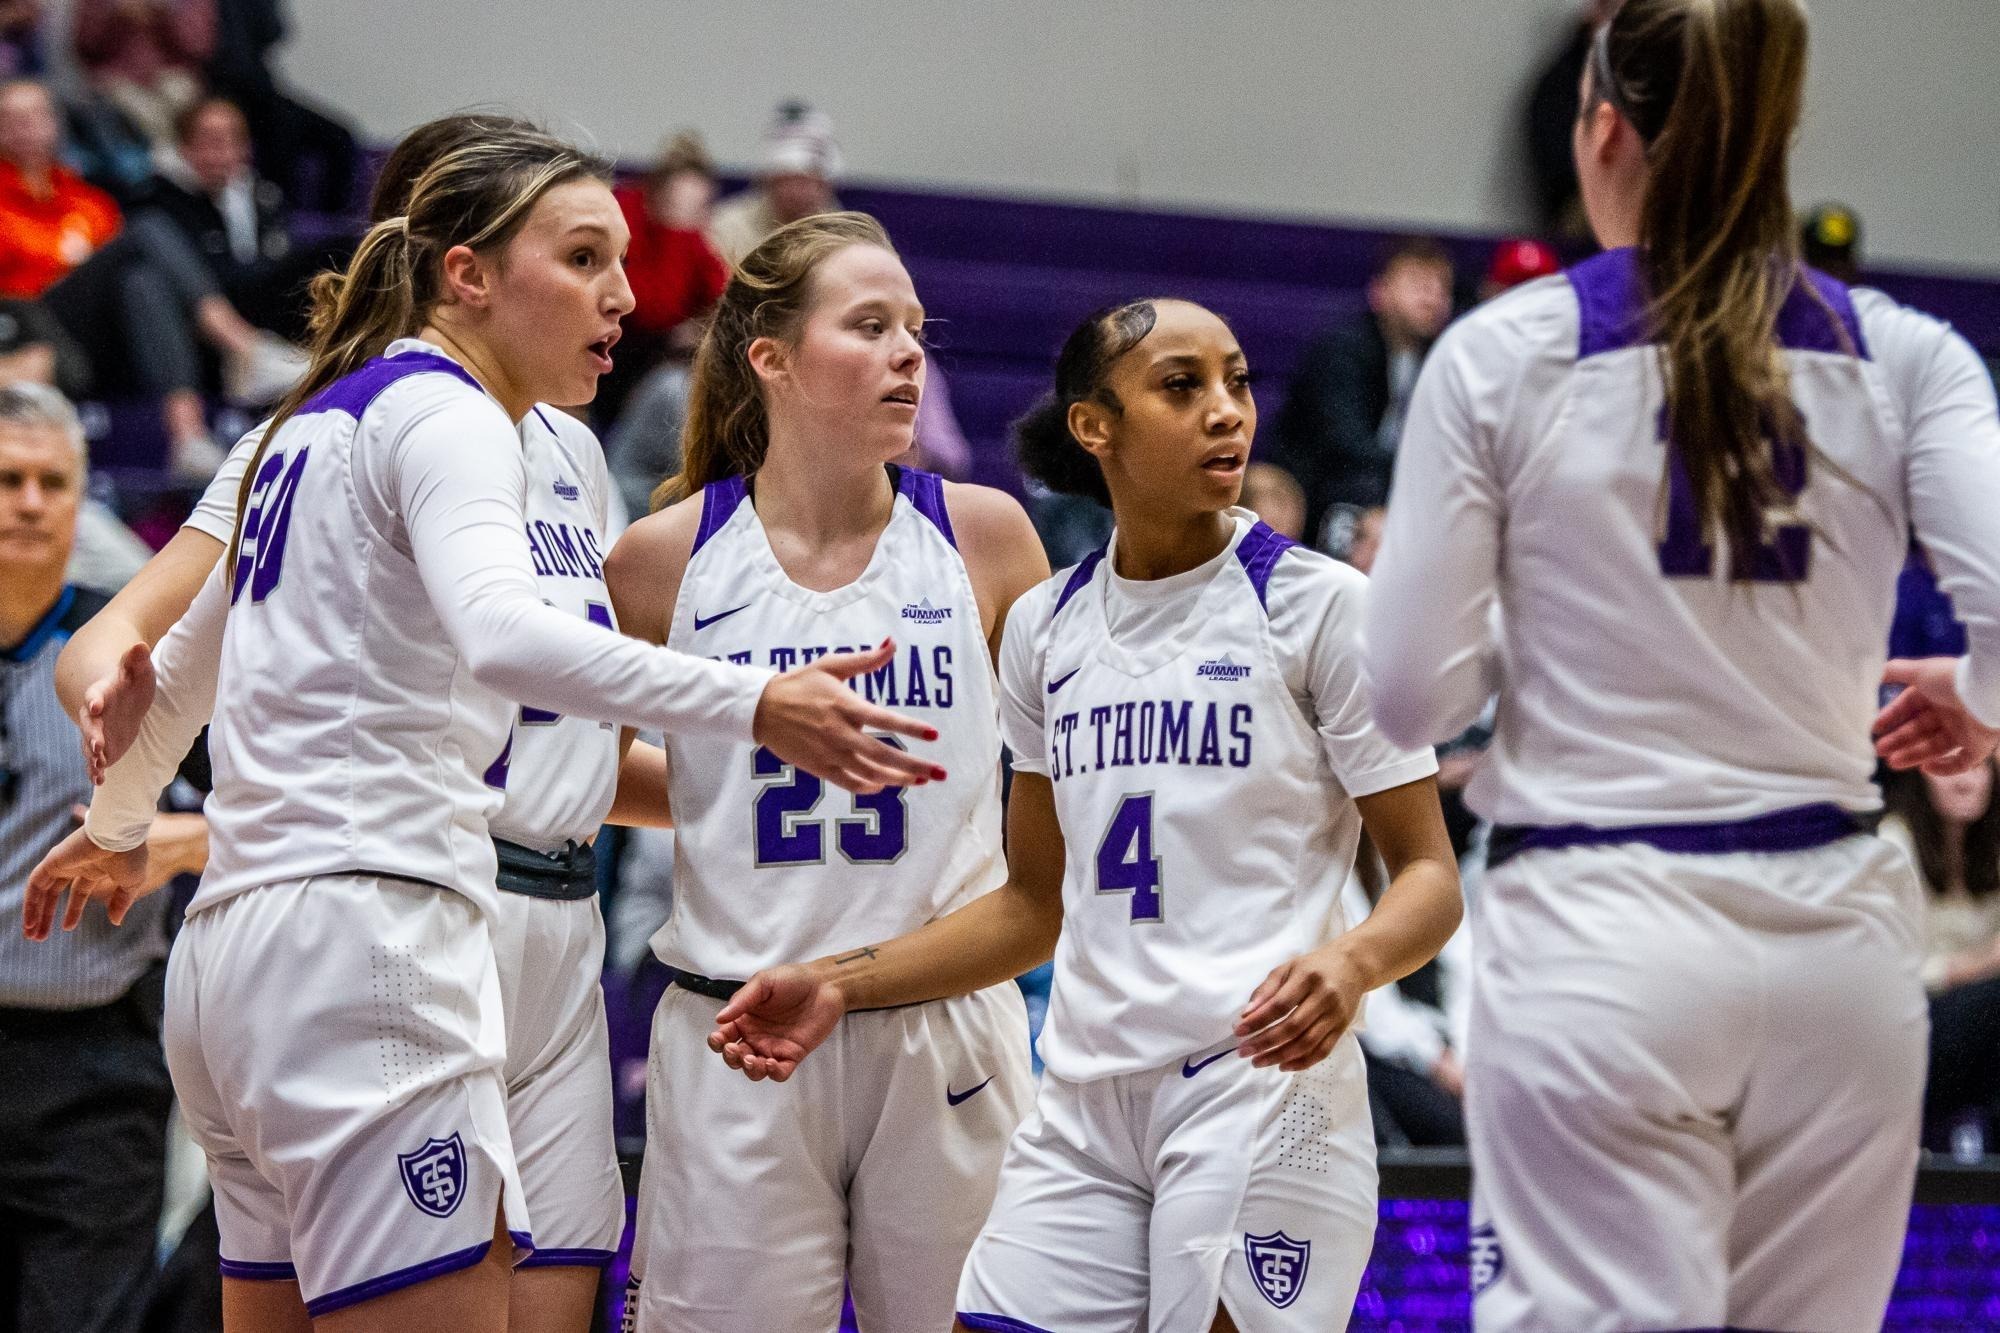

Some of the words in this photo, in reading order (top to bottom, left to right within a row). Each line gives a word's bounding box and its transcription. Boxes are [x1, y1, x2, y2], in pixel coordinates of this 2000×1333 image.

[901, 608, 953, 619] SUMMIT
[1196, 665, 1252, 677] SUMMIT
[750, 731, 908, 869] 23
[1094, 789, 1165, 926] 4
